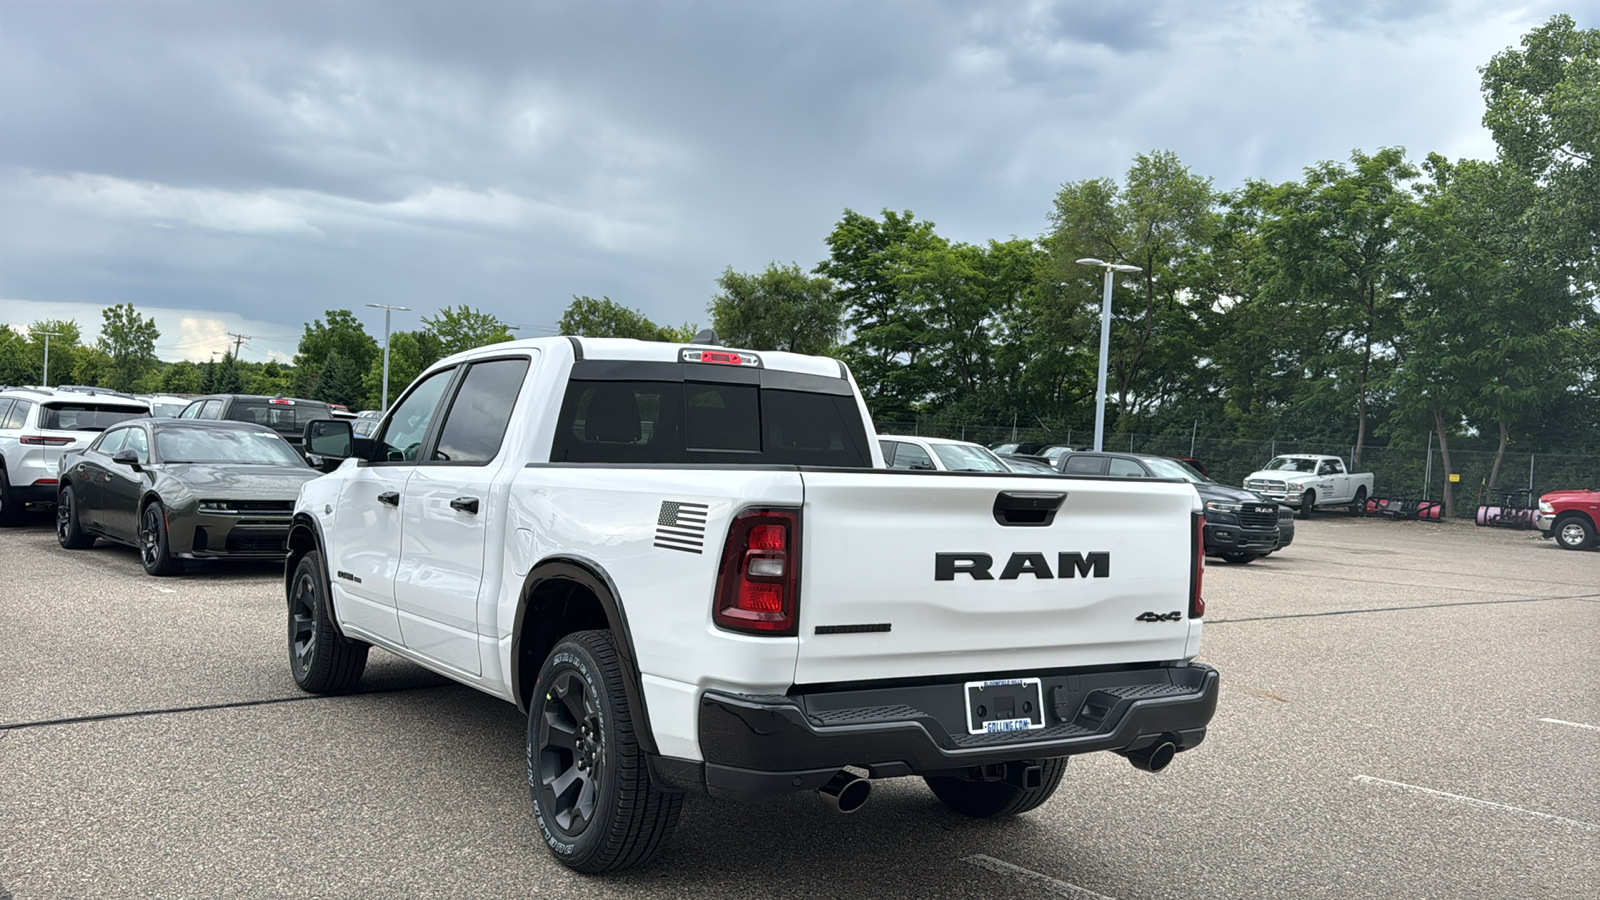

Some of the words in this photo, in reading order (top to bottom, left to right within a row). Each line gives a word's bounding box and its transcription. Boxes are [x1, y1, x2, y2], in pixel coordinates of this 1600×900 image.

[935, 551, 1110, 581] RAM
[1135, 610, 1182, 622] 4x4
[533, 799, 574, 855] DUELER
